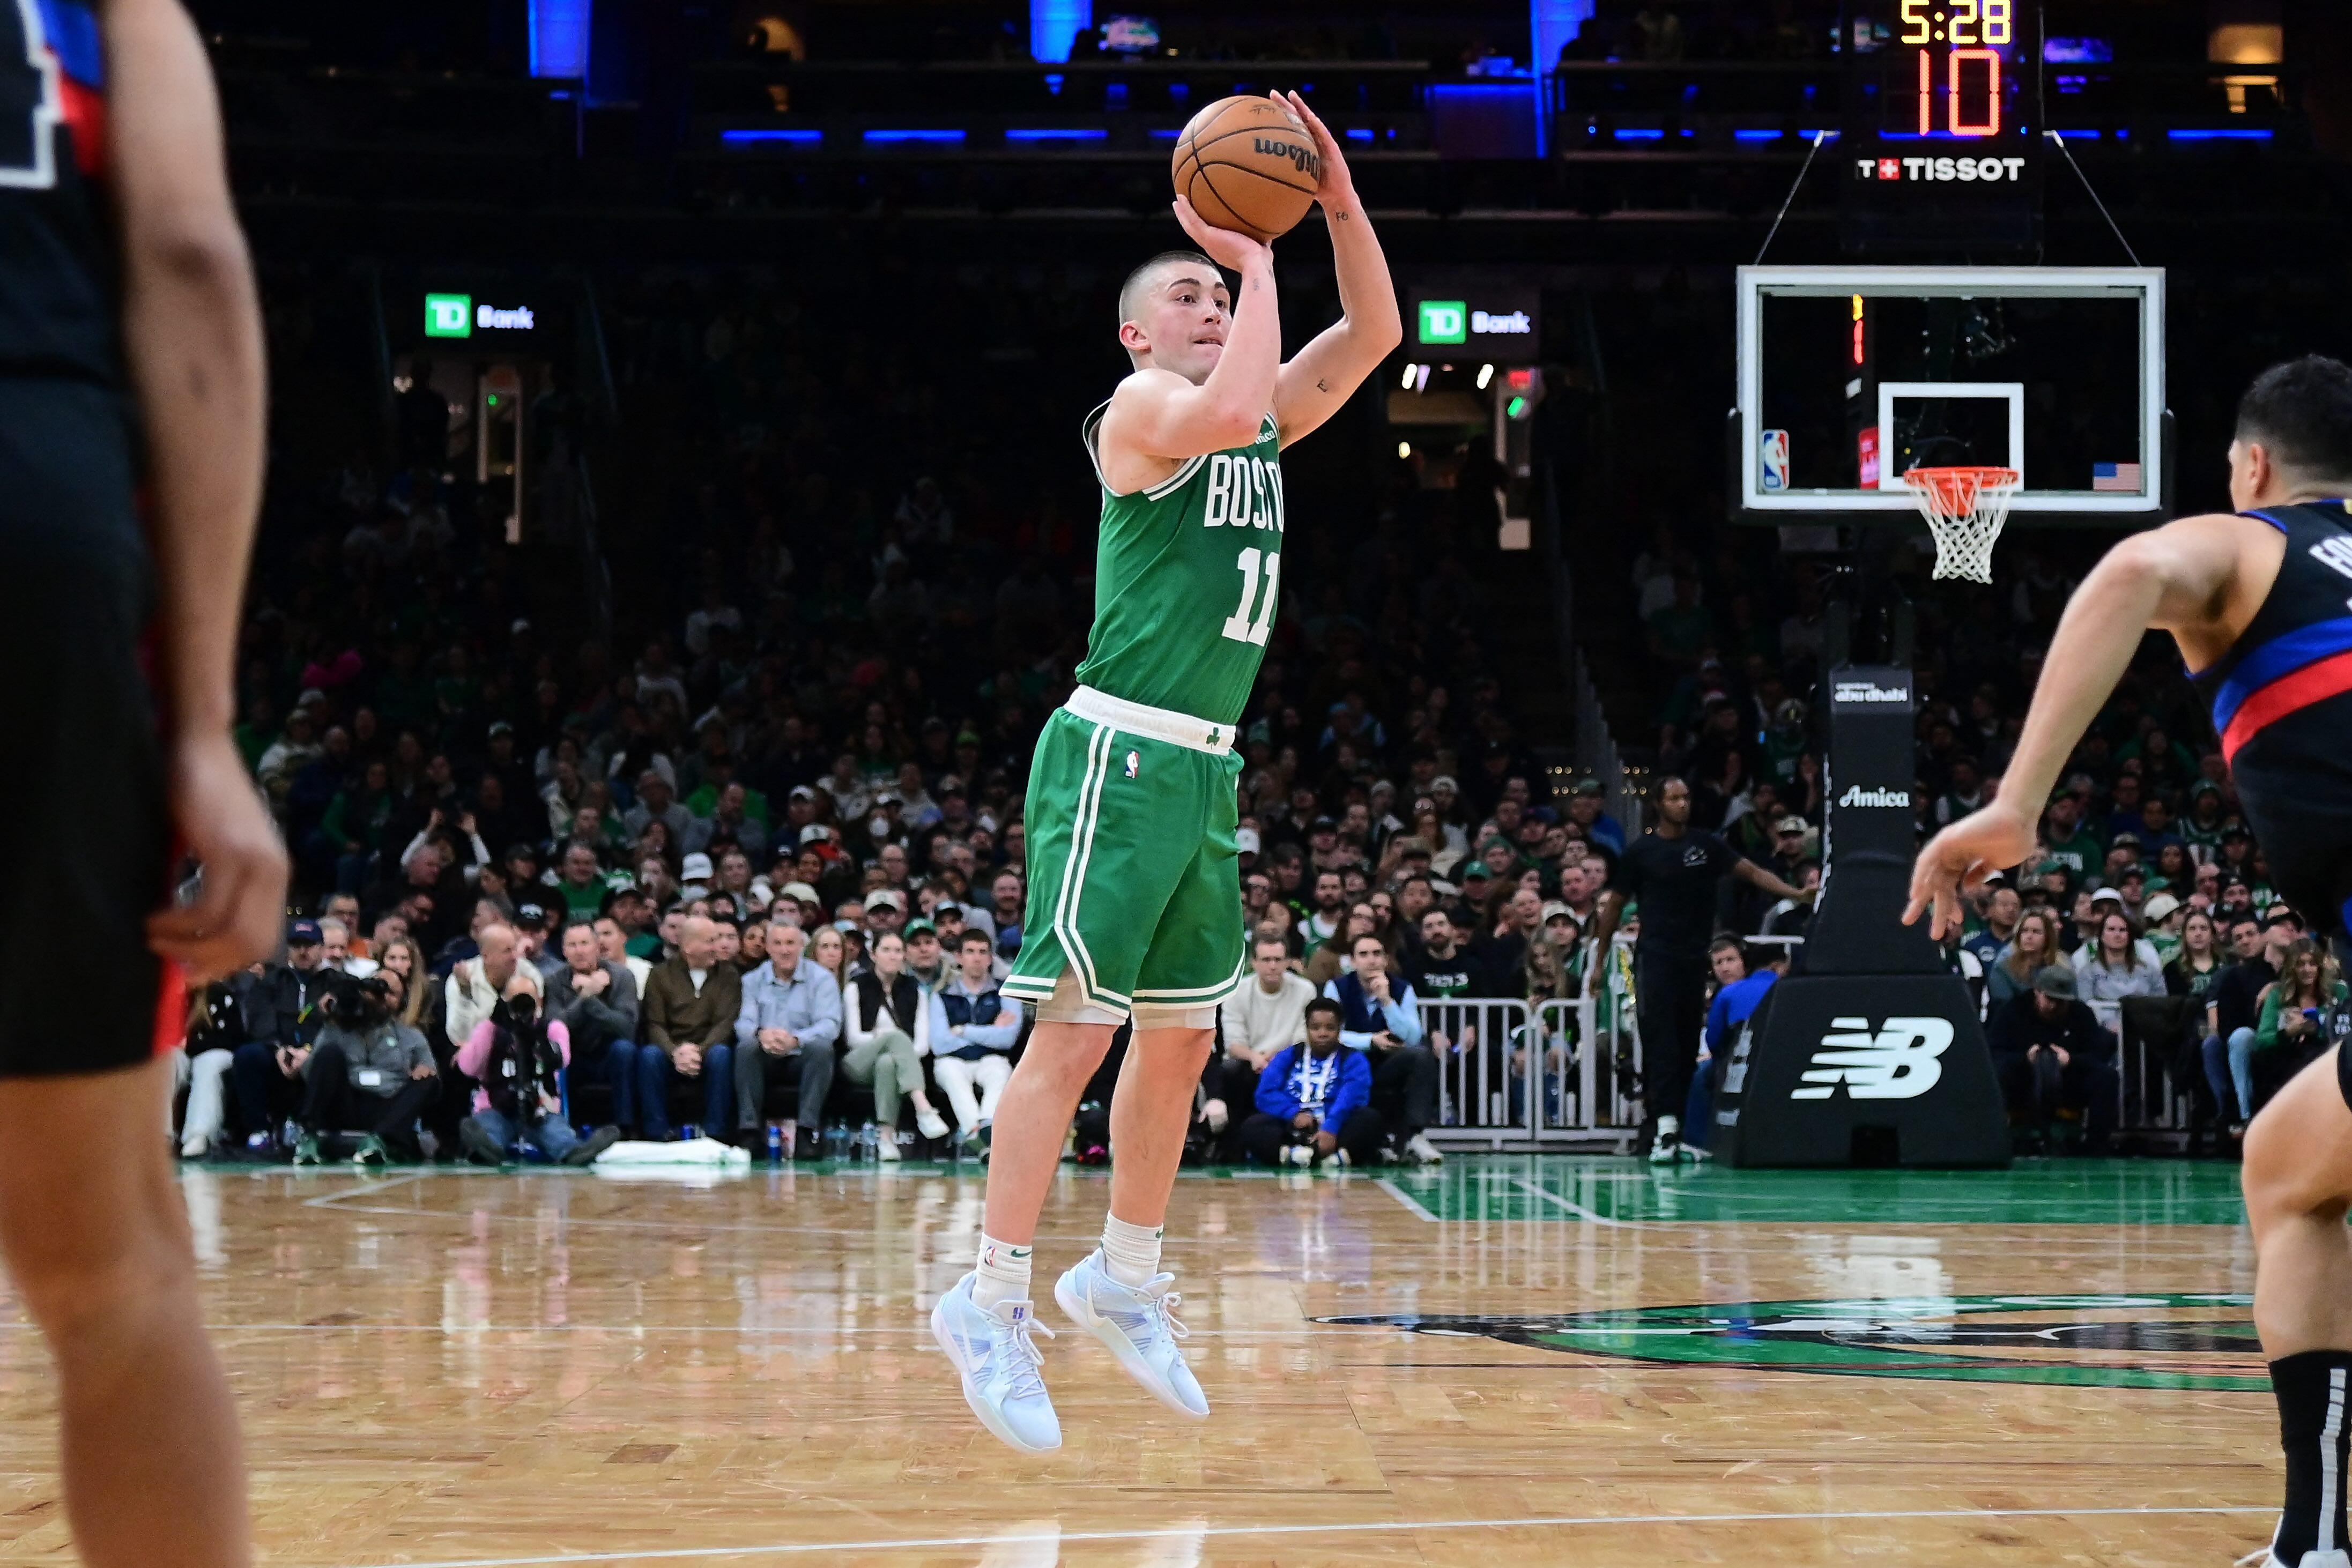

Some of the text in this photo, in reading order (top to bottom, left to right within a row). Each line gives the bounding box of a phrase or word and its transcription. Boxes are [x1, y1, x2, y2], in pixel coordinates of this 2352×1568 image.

[1901, 0, 2011, 44] 5:28
[1919, 49, 1999, 136] 10
[1902, 157, 2025, 182] TISSOT
[430, 301, 534, 331] TD Bank
[1423, 308, 1531, 336] TD Bank
[1221, 547, 1280, 647] 11
[1839, 784, 1910, 807] Amica
